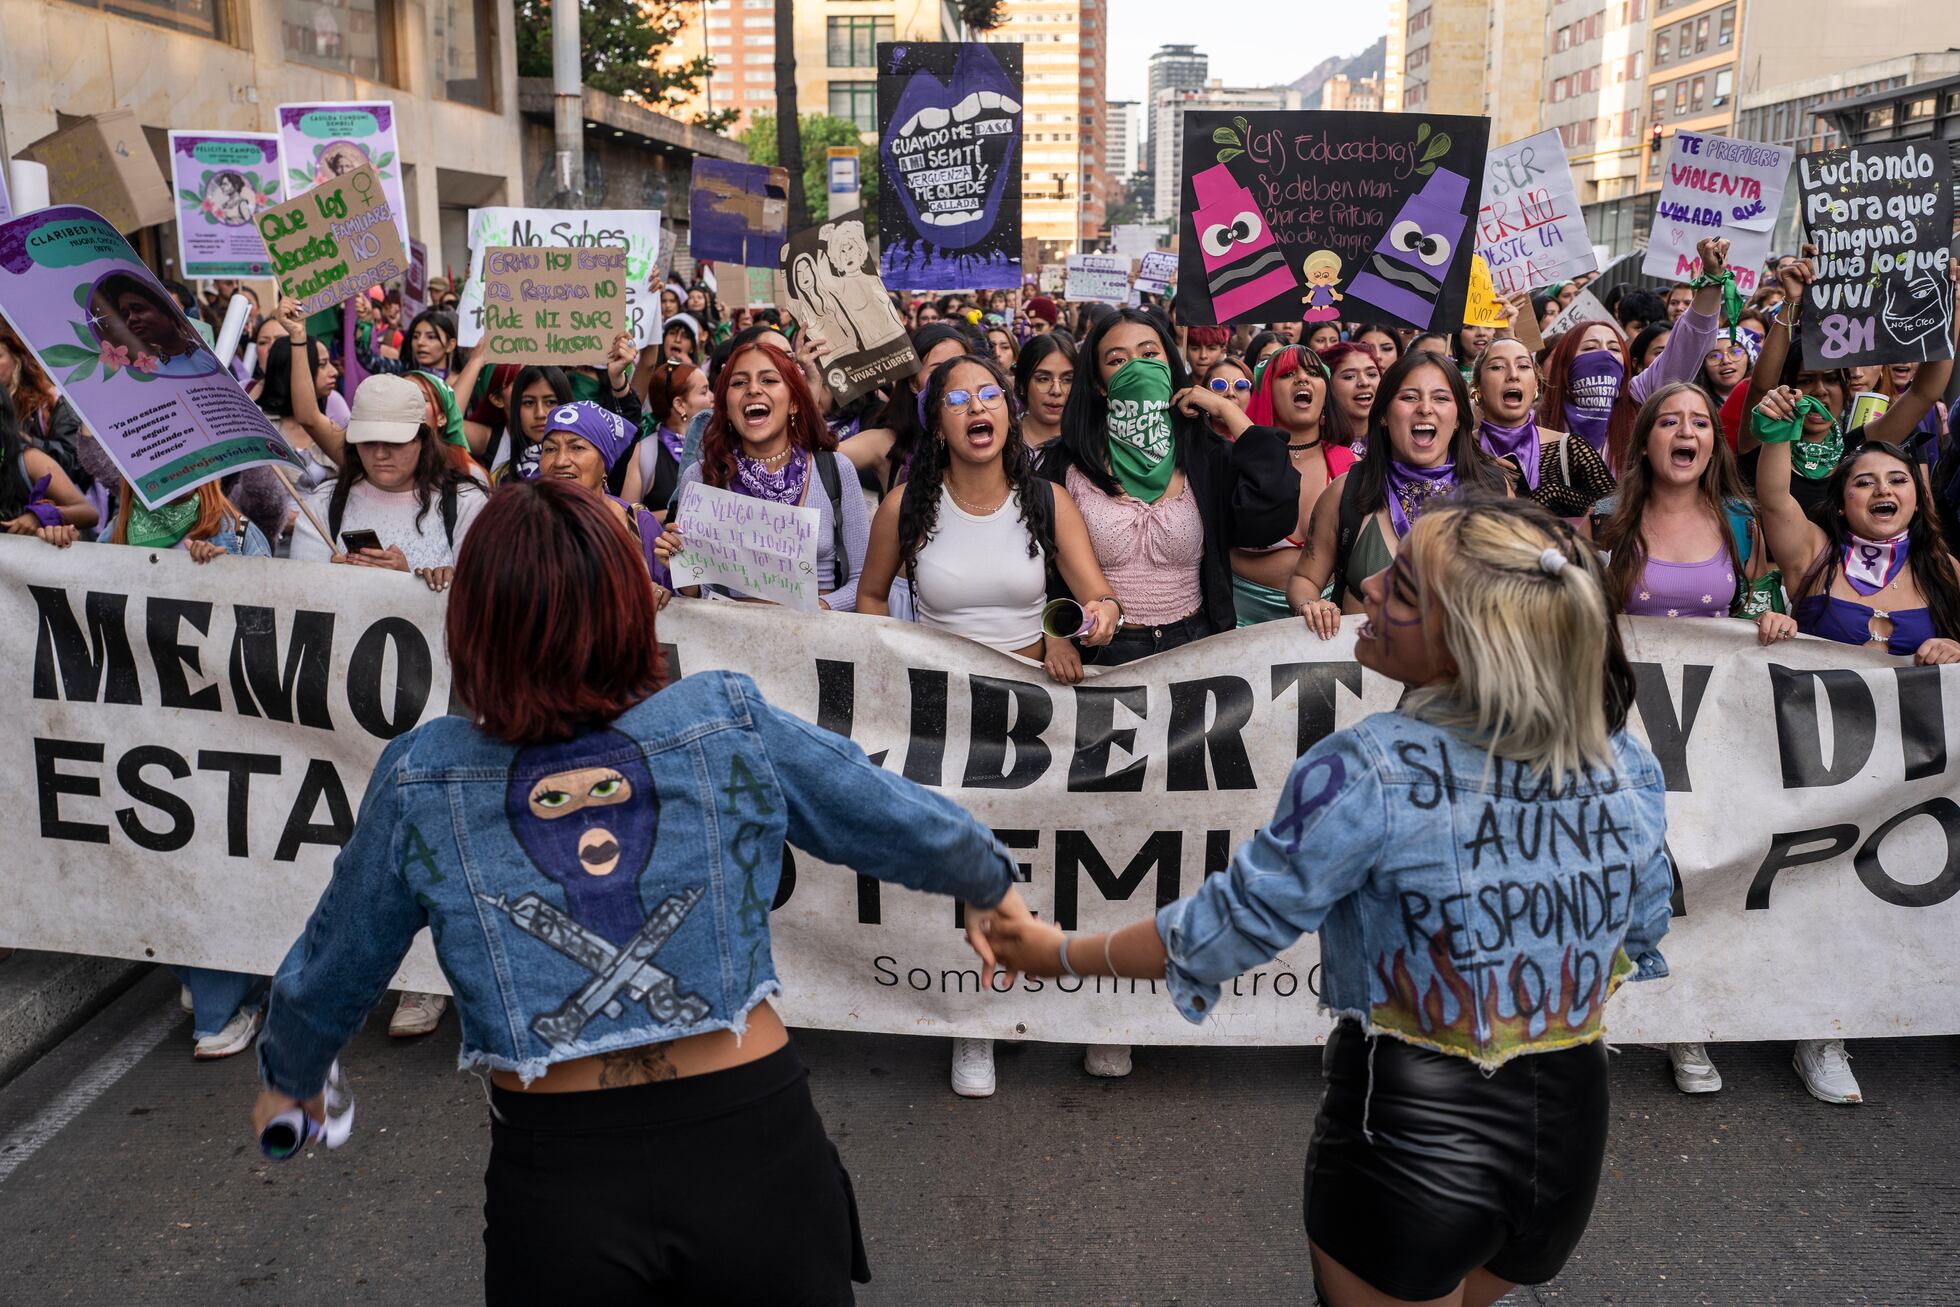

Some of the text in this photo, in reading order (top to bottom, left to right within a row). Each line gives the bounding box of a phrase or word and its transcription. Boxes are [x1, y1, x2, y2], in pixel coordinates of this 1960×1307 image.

[951, 123, 972, 140] ME
[1295, 129, 1417, 181] Educadoras
[1678, 134, 1703, 155] TE
[976, 164, 989, 180] Y
[1490, 146, 1546, 197] SER
[1800, 145, 1935, 191] Luchando
[914, 186, 936, 201] ME
[1257, 173, 1284, 208] Se
[1285, 173, 1354, 202] deben
[929, 198, 979, 211] CALLADA
[1302, 205, 1326, 226] de
[1517, 188, 1555, 227] NO
[1732, 200, 1766, 221] QUE
[30, 225, 89, 248] CLARIBED
[259, 208, 308, 241] Que
[1296, 226, 1323, 244] de
[1538, 222, 1564, 248] LA
[1671, 228, 1685, 246] Y
[350, 232, 382, 263] NO
[512, 219, 631, 256] No Sabes
[1810, 220, 1918, 256] ninguna
[300, 258, 400, 314] VIOLADORES
[594, 279, 618, 299] NO
[535, 308, 562, 330] NI
[1890, 321, 1904, 329] NO
[1904, 323, 1914, 332] te
[1820, 313, 1876, 359] 8M
[850, 367, 877, 383] VIVAS
[874, 364, 883, 374] Y
[882, 351, 915, 371] LIBRES
[127, 414, 138, 425] no
[139, 400, 177, 419] estamos
[121, 415, 168, 439] dispuestas
[141, 424, 171, 442] seguir
[130, 427, 195, 459] aguantando en
[815, 657, 1364, 793] LIBERT
[1394, 738, 1457, 811] SI
[1399, 860, 1638, 961] RESPONDE
